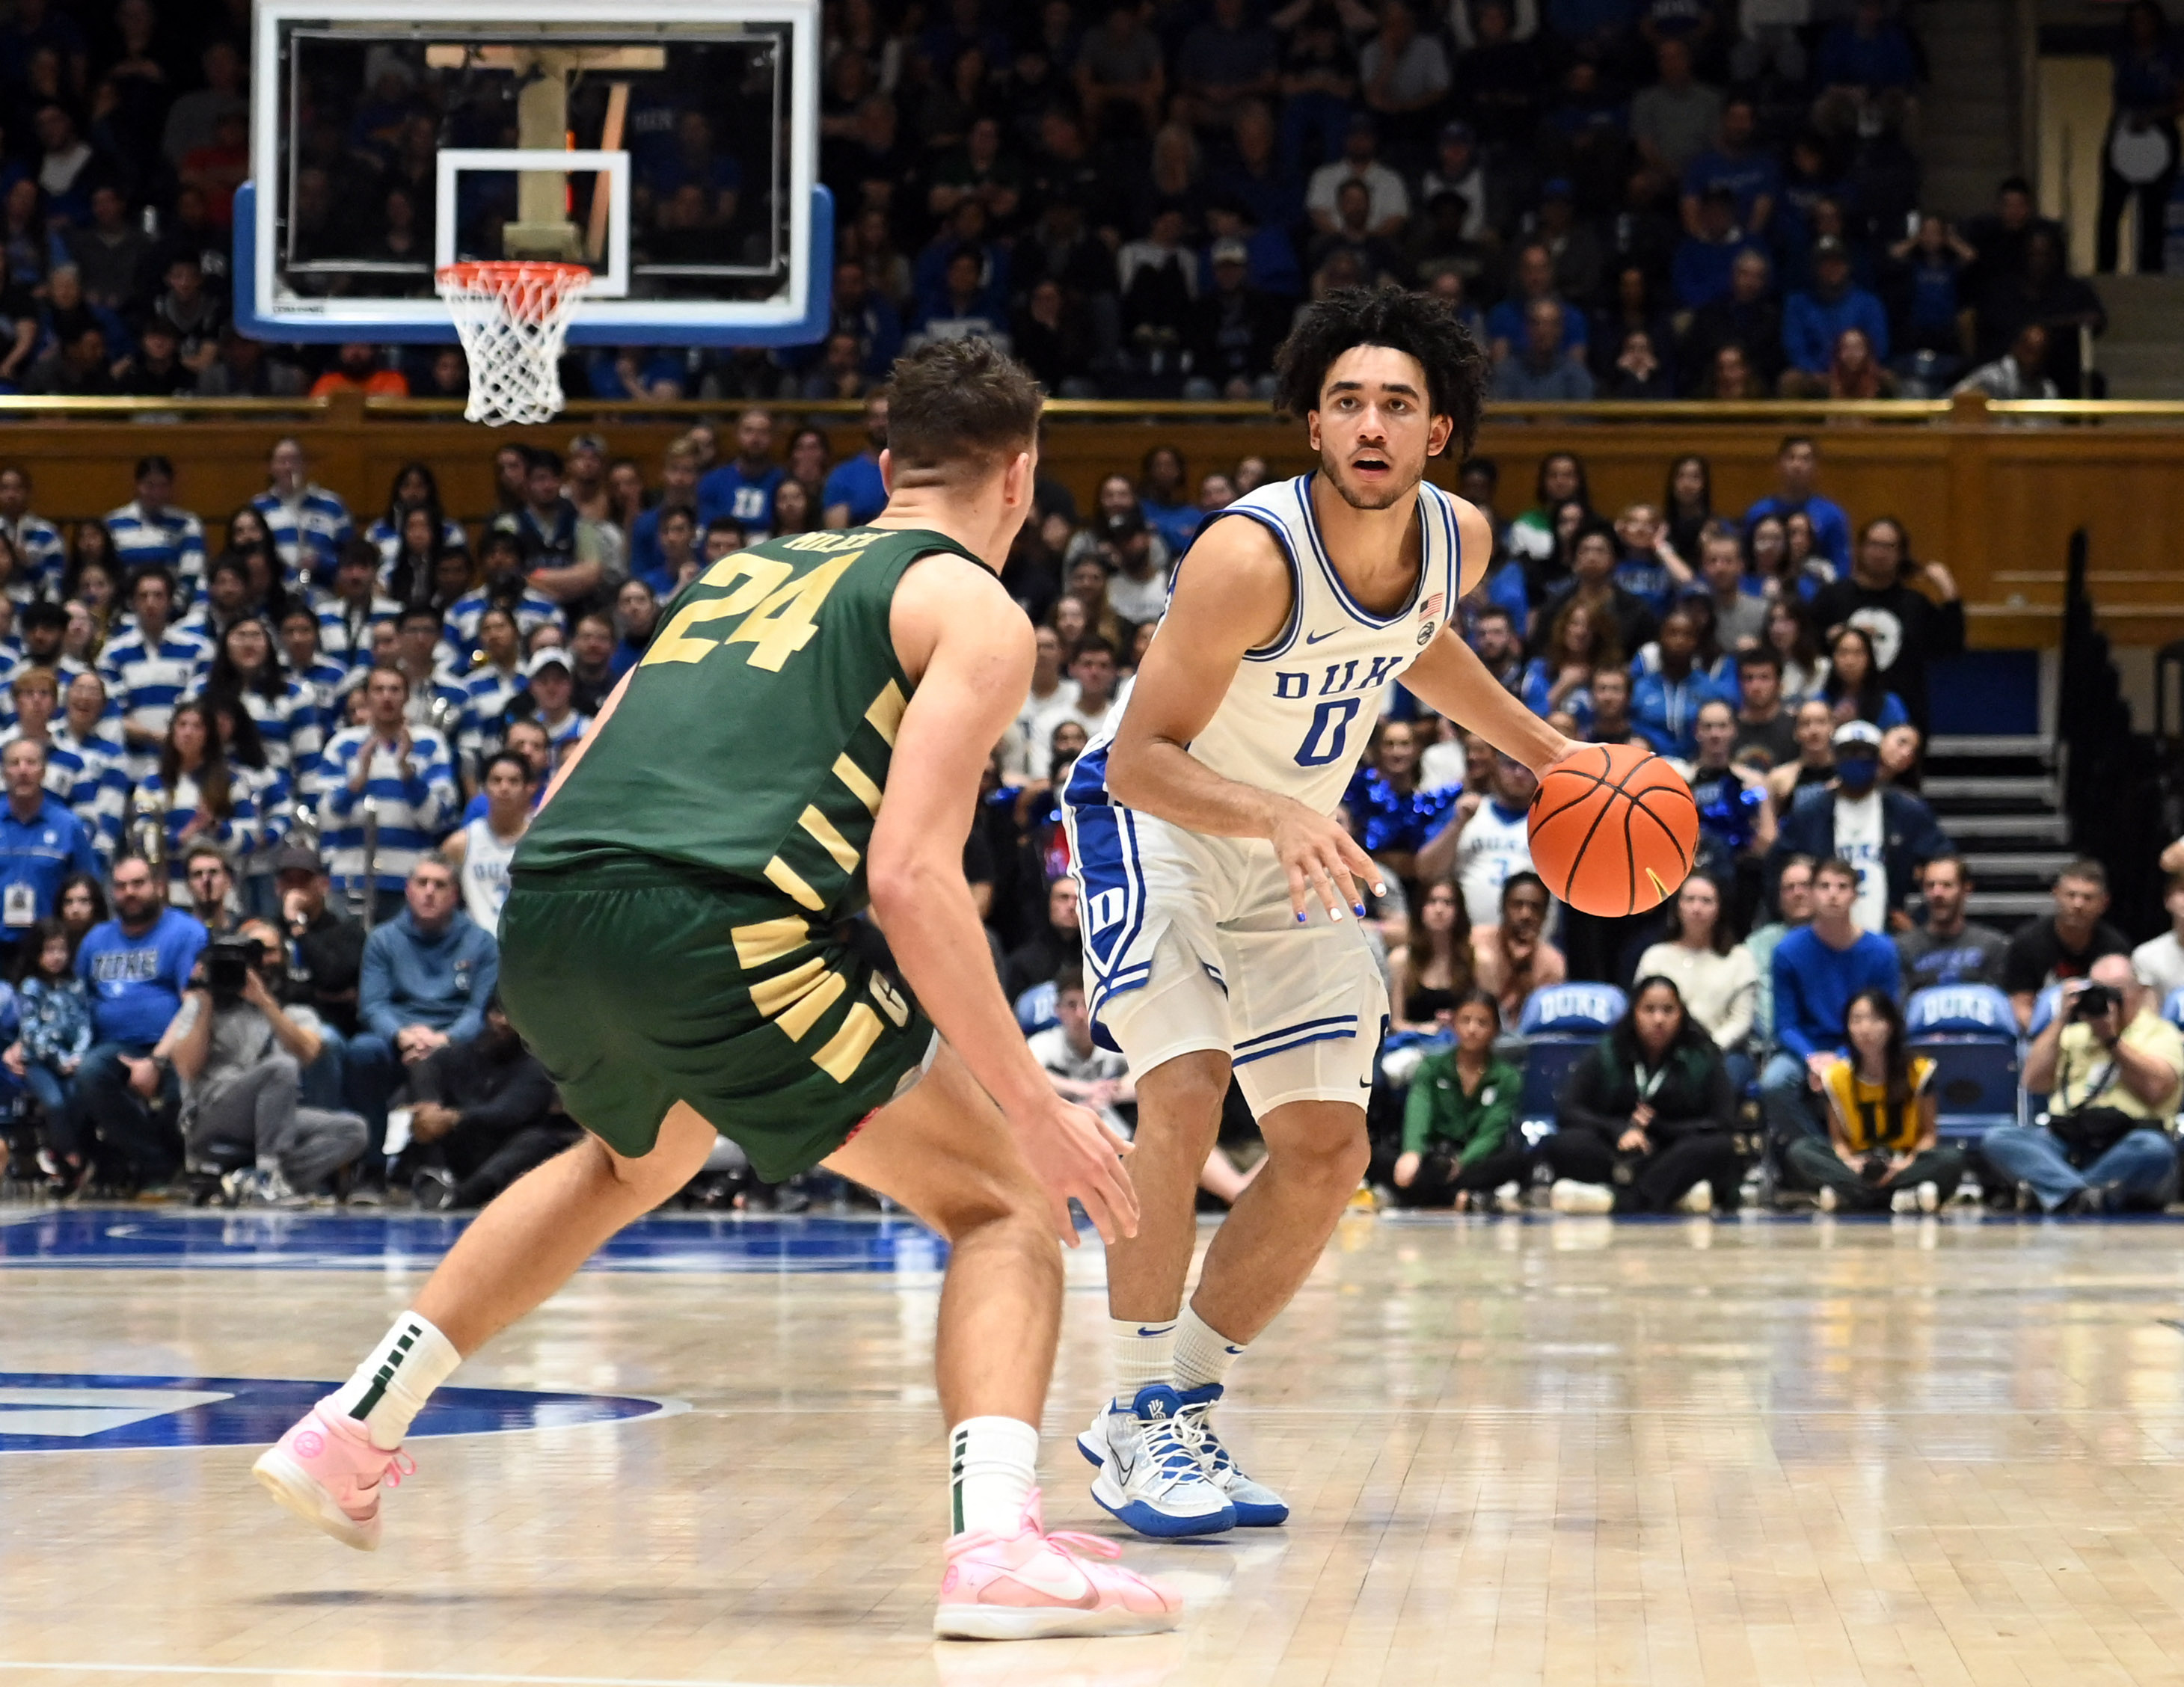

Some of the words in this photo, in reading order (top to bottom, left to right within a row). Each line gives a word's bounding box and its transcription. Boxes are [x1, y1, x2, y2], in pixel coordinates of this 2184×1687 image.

[639, 552, 865, 673] 24
[1273, 656, 1404, 698] DUK
[1293, 697, 1361, 767] 0
[1089, 887, 1125, 936] D
